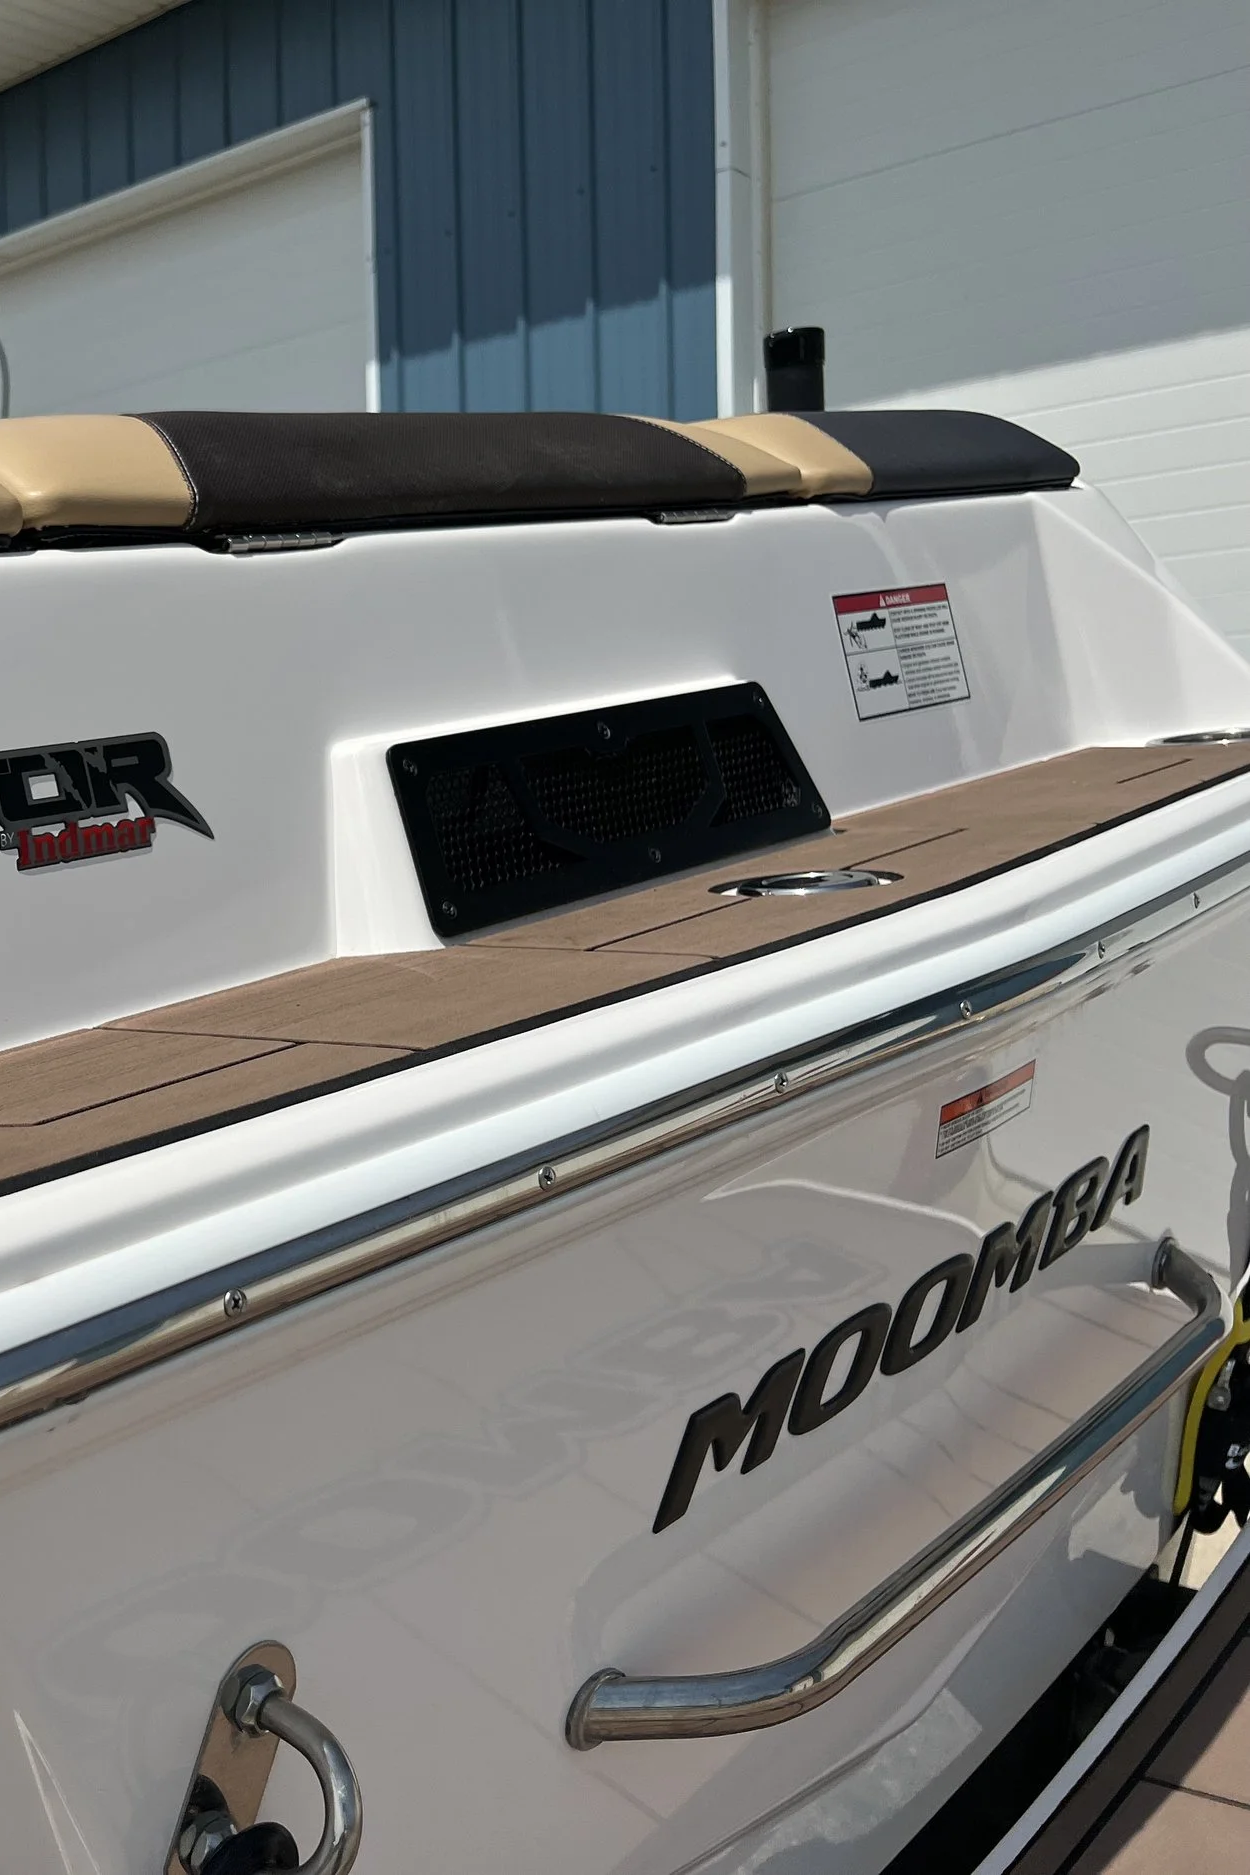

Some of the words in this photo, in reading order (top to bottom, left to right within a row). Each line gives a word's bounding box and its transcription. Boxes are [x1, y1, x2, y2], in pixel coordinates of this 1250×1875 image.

[885, 593, 911, 605] DANGER
[0, 832, 15, 848] BY
[18, 816, 156, 869] Indmar
[652, 1124, 1151, 1534] MOOMBA
